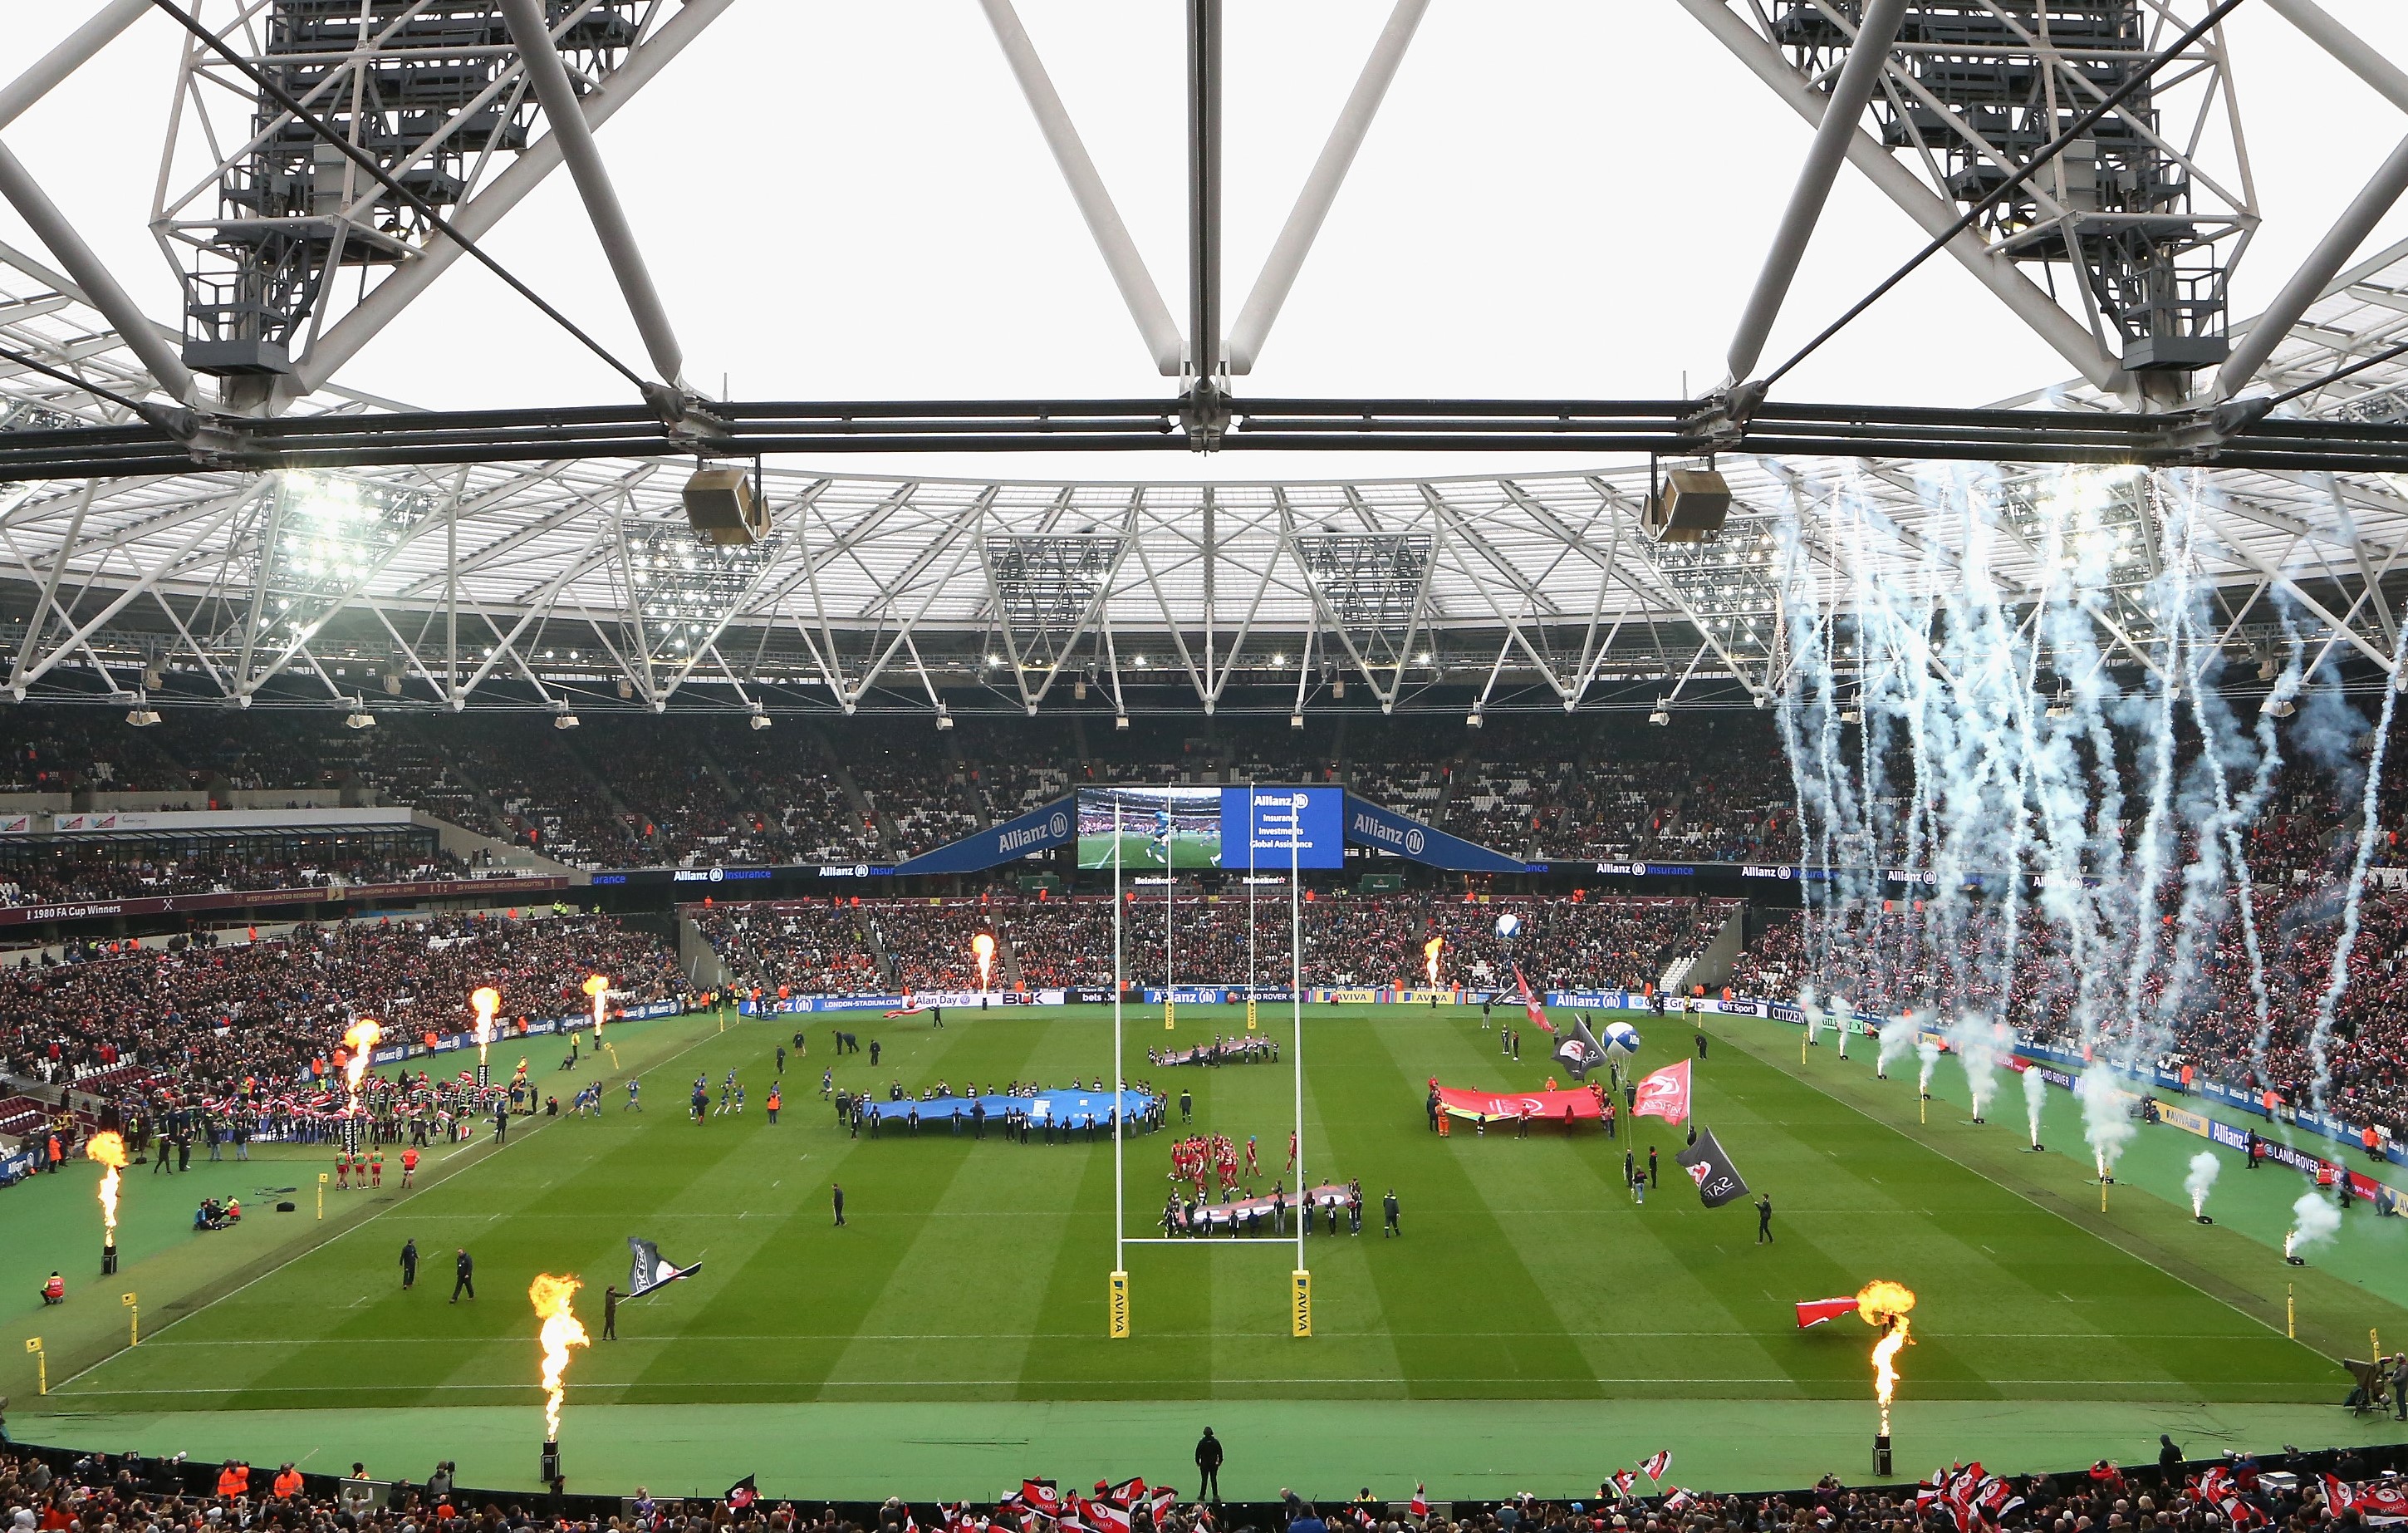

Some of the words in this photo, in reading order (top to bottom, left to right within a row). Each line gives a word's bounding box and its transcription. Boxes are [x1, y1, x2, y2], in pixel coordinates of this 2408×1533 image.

[1253, 795, 1292, 807] Allianz
[1354, 813, 1403, 845] Allianz
[998, 824, 1048, 853] Allianz
[1274, 840, 1313, 848] Assisance
[819, 867, 854, 877] Allianz
[870, 867, 895, 875] Insur
[1596, 863, 1631, 873] Allianz
[1647, 866, 1694, 875] Insurance
[1741, 867, 1776, 877] Allianz
[593, 874, 625, 884] urance
[674, 871, 708, 882] Allianz
[724, 869, 771, 880] Insurance
[1887, 871, 1922, 882] Allianz
[34, 908, 55, 920] 1980
[56, 907, 67, 917] FA
[69, 906, 86, 918] Cup
[87, 904, 121, 915] Winners
[824, 999, 901, 1008] LONDON-STADIUM.COM
[915, 995, 938, 1005] Alan
[940, 995, 958, 1005] Day
[1556, 995, 1601, 1008] Allianz
[649, 1005, 669, 1015] Allianz
[1722, 1003, 1734, 1012] BT
[1734, 1004, 1755, 1015] Sport
[1773, 1006, 1806, 1024] CITIZEN
[375, 1050, 395, 1063] Allianz
[2052, 1071, 2069, 1087] ROVER
[2205, 1081, 2219, 1092] Allianz
[2229, 1088, 2244, 1100] Allianz
[2170, 1112, 2190, 1126] AVIVA
[2299, 1109, 2313, 1122] Allianz
[2213, 1122, 2244, 1149] Allianz
[2347, 1125, 2361, 1137] Allian
[2274, 1147, 2294, 1164] LAND
[2296, 1153, 2318, 1173] ROVER
[1115, 1293, 1124, 1333] AVIVA
[1298, 1291, 1307, 1331] AVIVA
